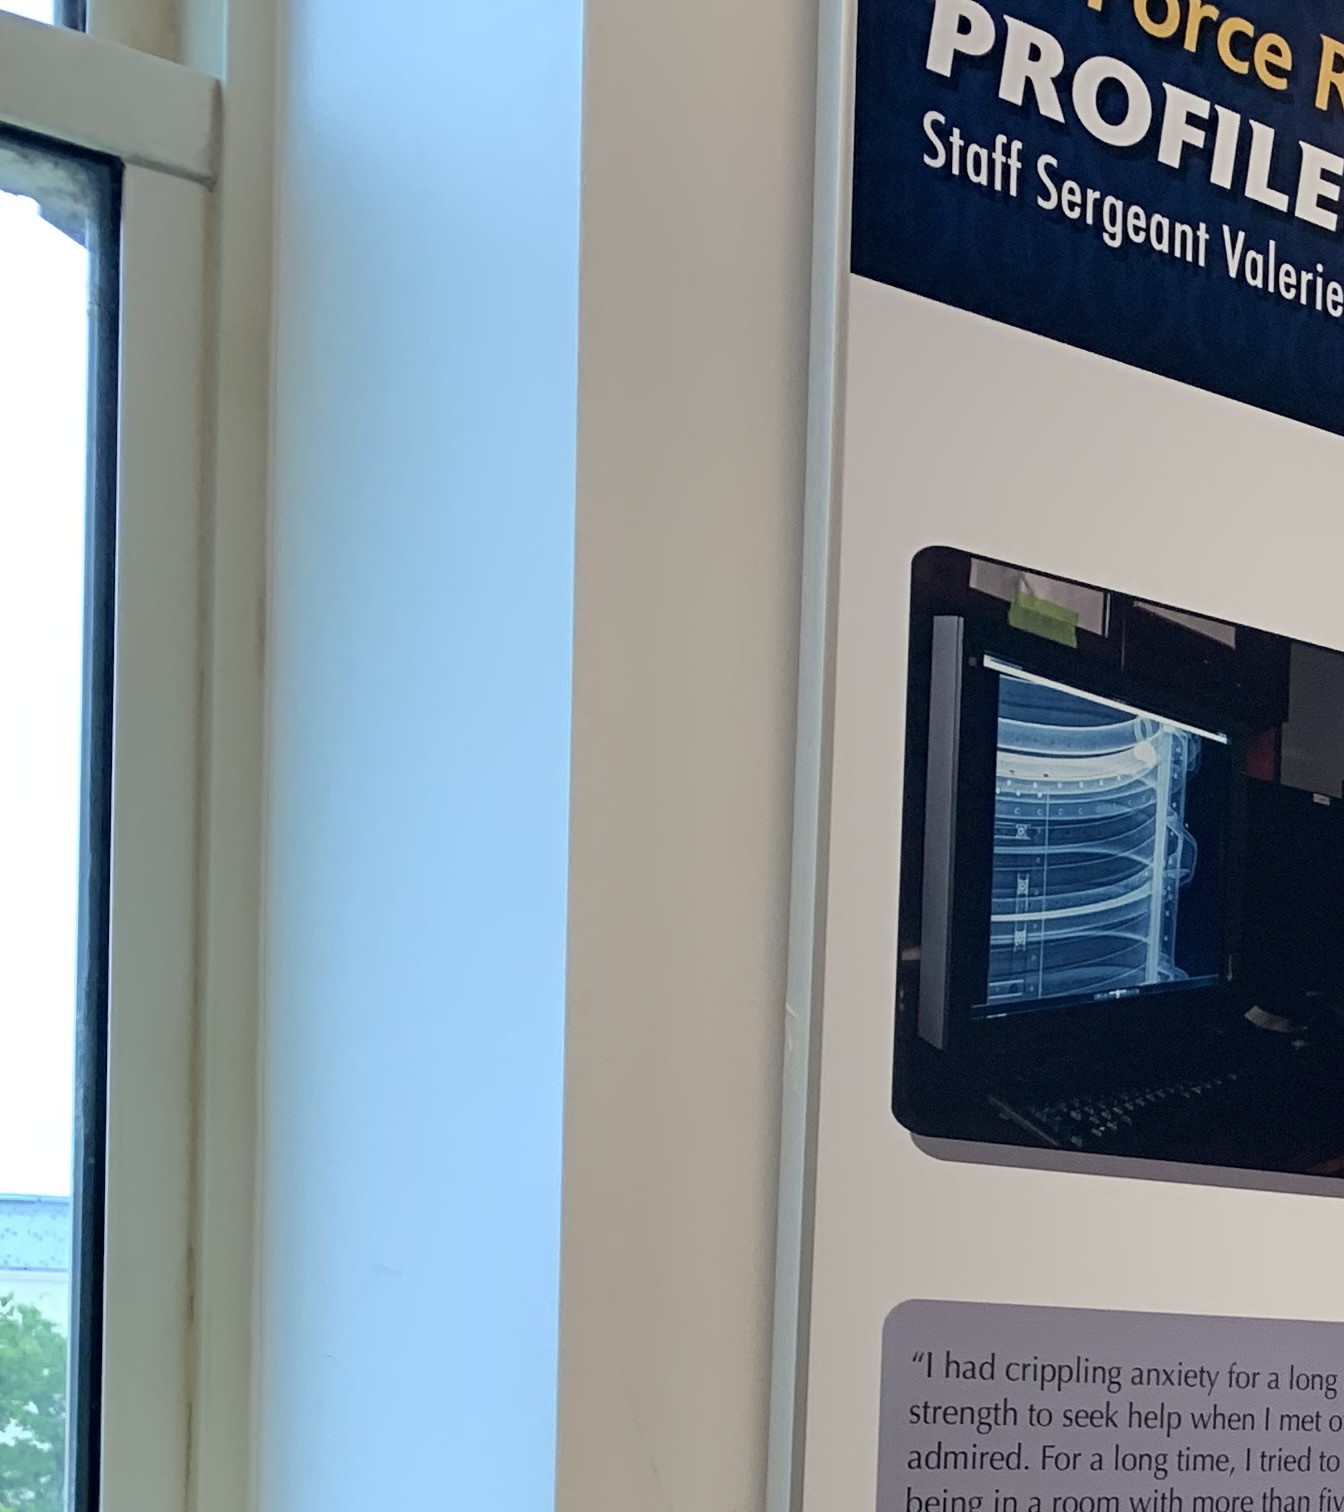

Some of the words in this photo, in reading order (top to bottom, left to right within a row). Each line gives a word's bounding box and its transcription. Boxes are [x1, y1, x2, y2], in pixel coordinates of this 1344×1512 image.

[1087, 0, 1293, 90] orce
[923, 111, 1022, 197] Staff
[1037, 154, 1209, 266] Sergeant
[1223, 225, 1344, 317] Valerie
[909, 1398, 1018, 1435] strength
[1028, 1403, 1053, 1427] to
[1062, 1400, 1118, 1428] seek
[1128, 1401, 1182, 1438] help
[1190, 1403, 1255, 1431] when
[1264, 1407, 1270, 1431] I
[1279, 1411, 1322, 1433] met
